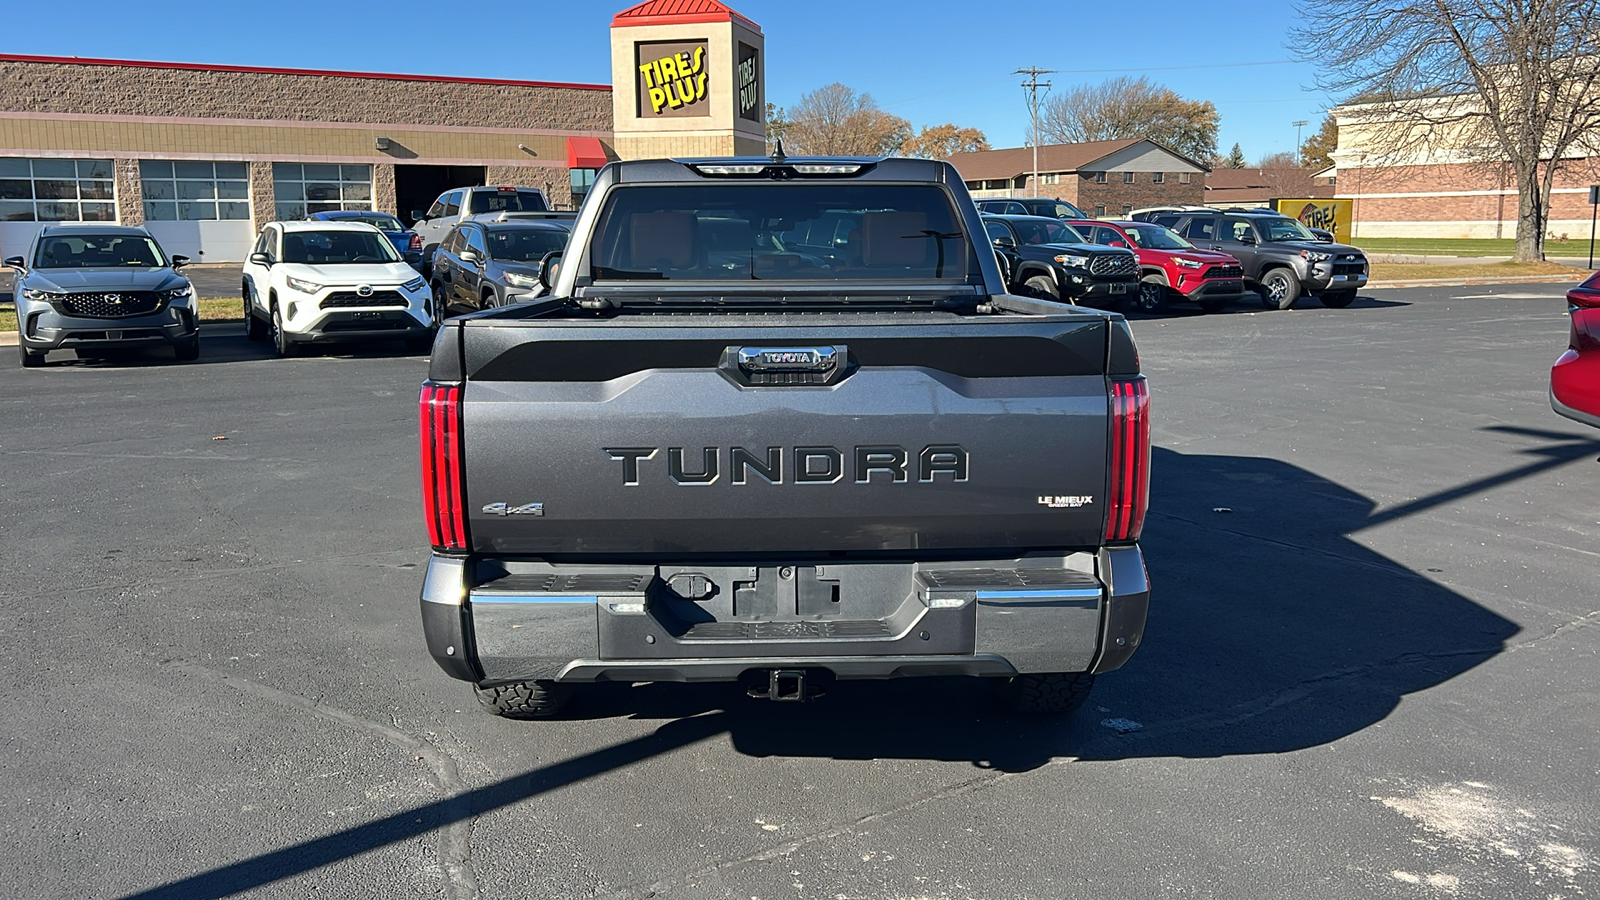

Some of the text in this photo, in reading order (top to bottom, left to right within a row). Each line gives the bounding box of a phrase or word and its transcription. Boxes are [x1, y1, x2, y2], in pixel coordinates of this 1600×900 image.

[639, 46, 705, 89] TIRES
[738, 56, 756, 89] TIRES
[648, 72, 708, 114] PLUS
[740, 81, 757, 114] PLUS
[1304, 204, 1336, 229] TIRES
[764, 353, 810, 363] TOYOTA
[602, 445, 970, 487] TUNDRA
[1038, 495, 1093, 504] LE MIEUX
